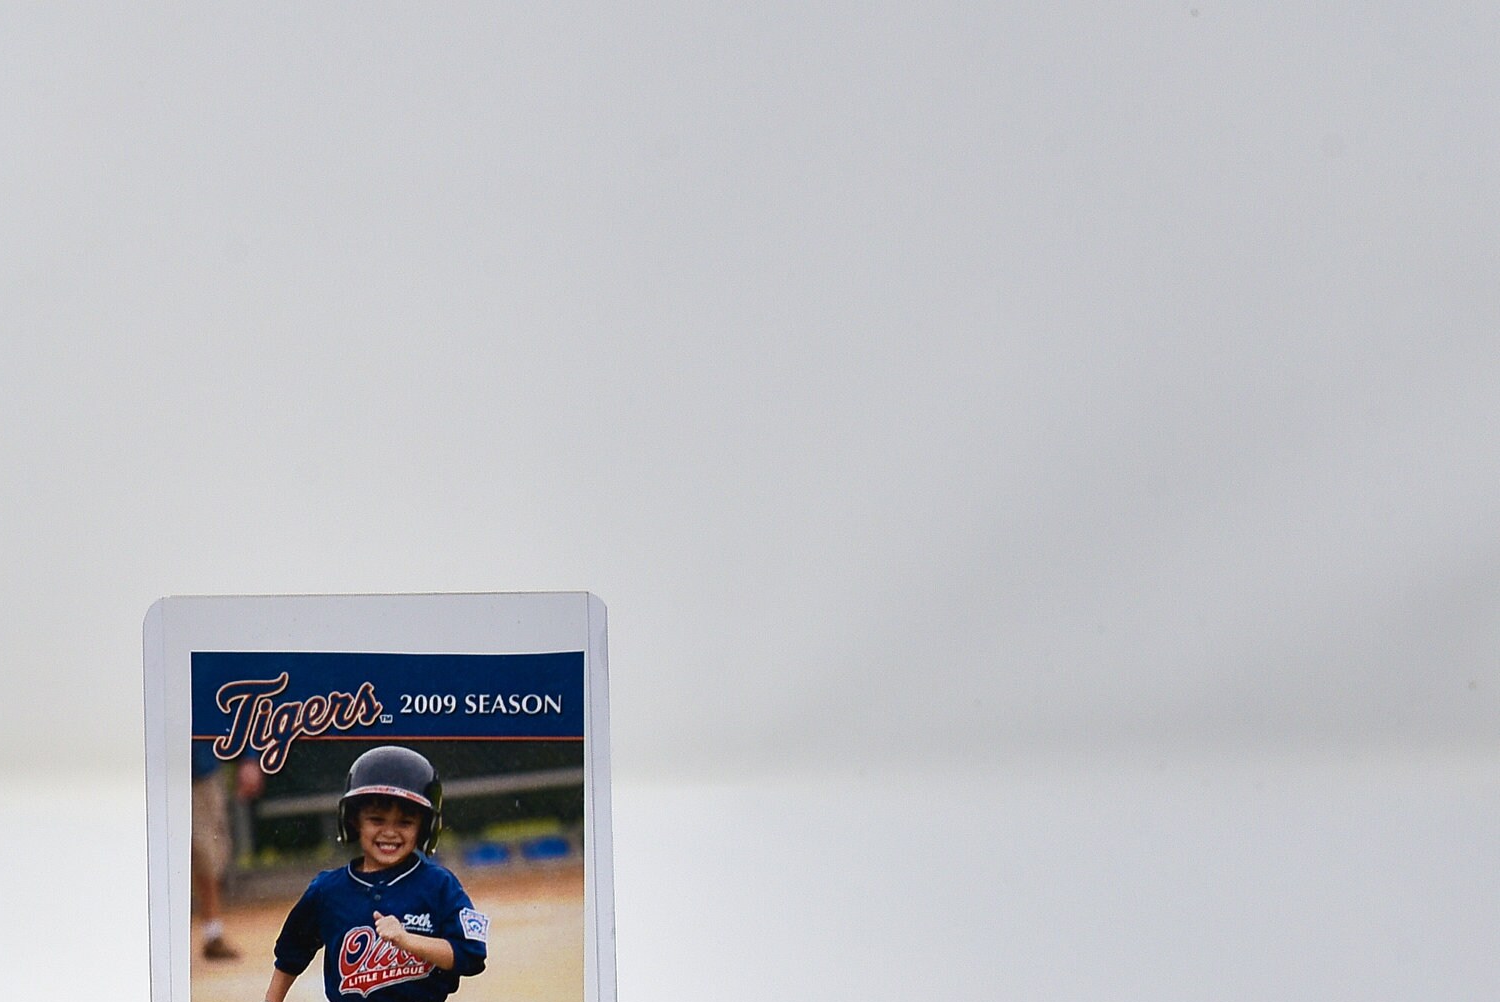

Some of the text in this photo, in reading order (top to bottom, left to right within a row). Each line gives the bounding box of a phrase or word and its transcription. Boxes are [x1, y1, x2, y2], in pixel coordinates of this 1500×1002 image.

[400, 693, 562, 715] 2009 SEASON
[213, 671, 383, 774] Tigers
[403, 912, 434, 929] 50th
[348, 965, 425, 987] LITTLE LEAGUE
